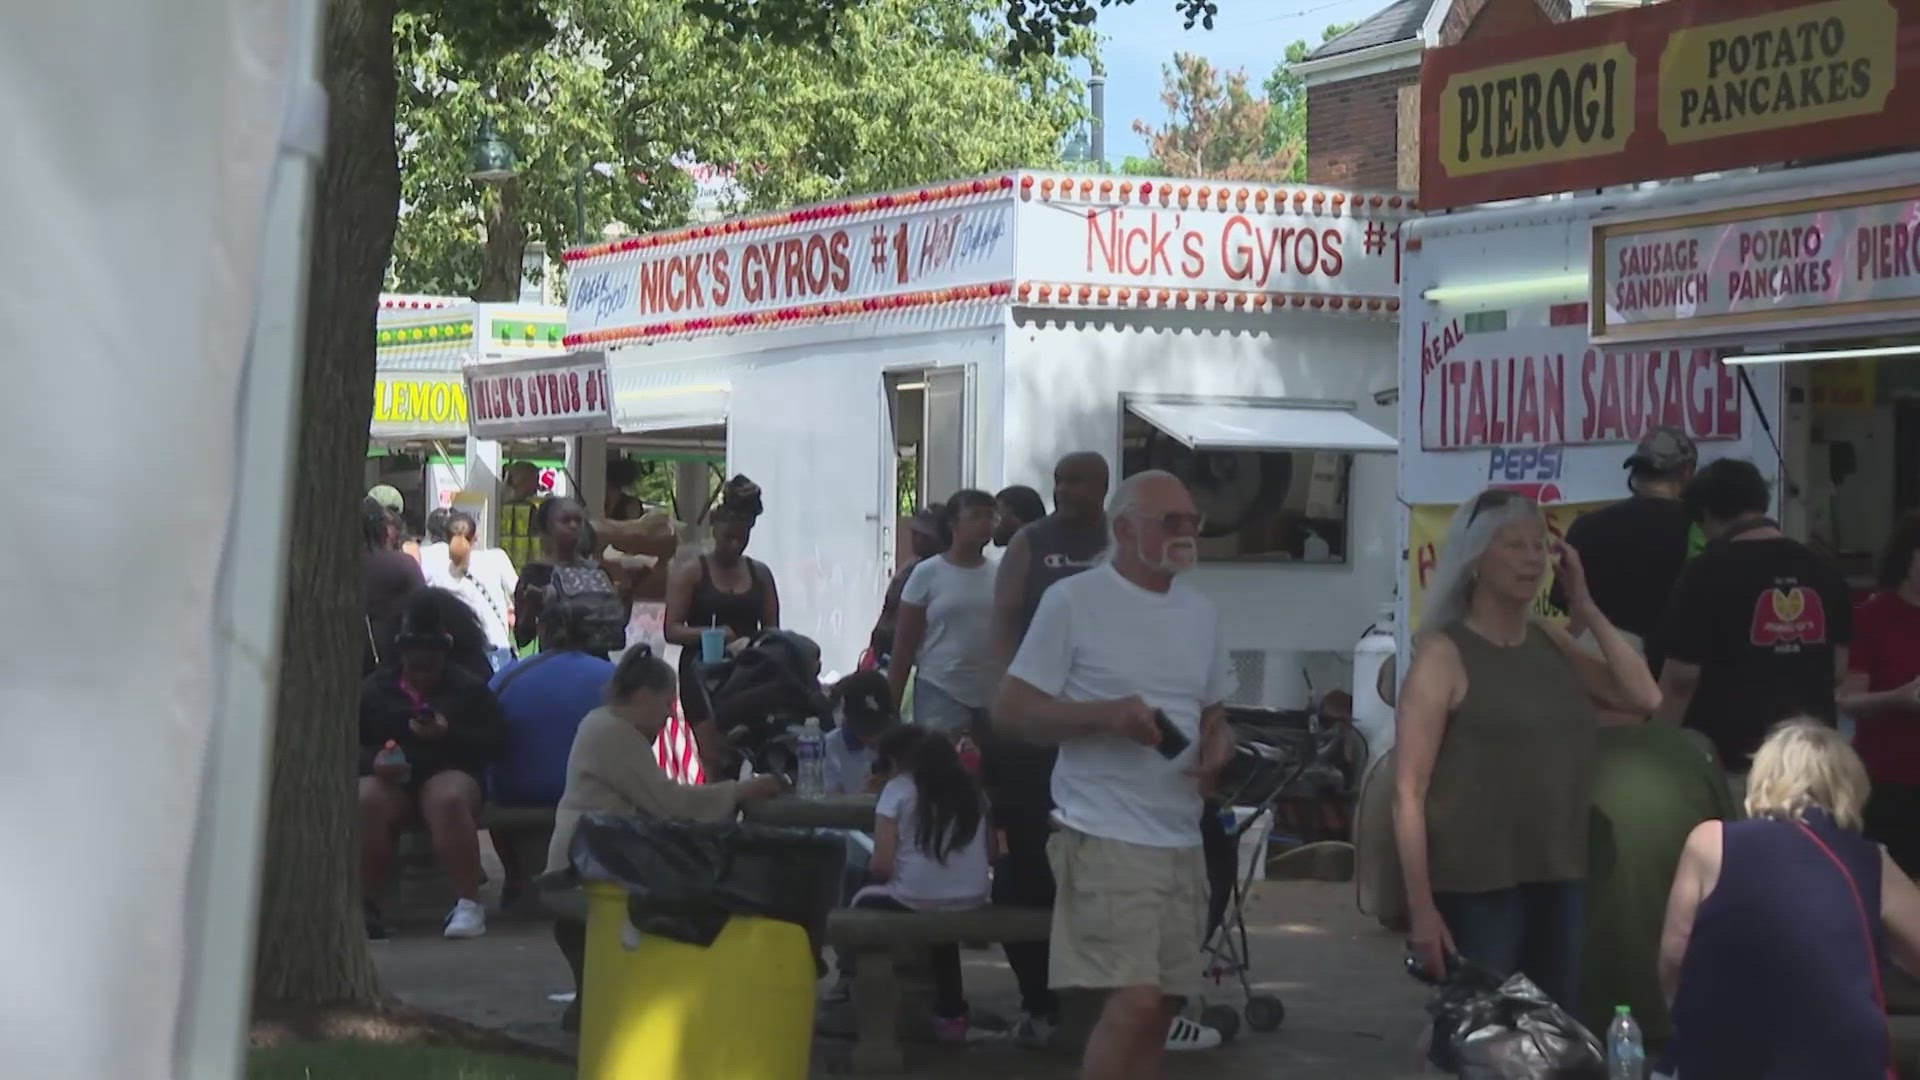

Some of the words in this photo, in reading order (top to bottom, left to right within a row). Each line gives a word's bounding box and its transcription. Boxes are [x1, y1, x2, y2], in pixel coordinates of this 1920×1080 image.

[1707, 16, 1845, 78] POTATO
[1457, 58, 1617, 163] PIEROGI
[1680, 57, 1872, 128] PANCAKES
[640, 248, 731, 316] NICK'S
[741, 229, 852, 302] GYROS
[870, 222, 909, 284] #1
[919, 213, 962, 278] HOT
[1086, 209, 1205, 279] Nick's
[1221, 213, 1344, 288] Gyros
[1619, 239, 1698, 278] SAUSAGE
[1740, 225, 1822, 264] POTATO
[1615, 273, 1708, 312] SANDWICH
[1729, 259, 1831, 300] PANCAKES
[1422, 317, 1464, 375] REAL
[373, 380, 468, 424] LEMON
[473, 377, 525, 420] NICK'S
[528, 371, 581, 416] GYROS
[586, 369, 607, 411] #1
[1440, 353, 1565, 446] ITALIAN
[1582, 348, 1741, 442] SAUSAGE
[1488, 447, 1563, 481] PEPSI
